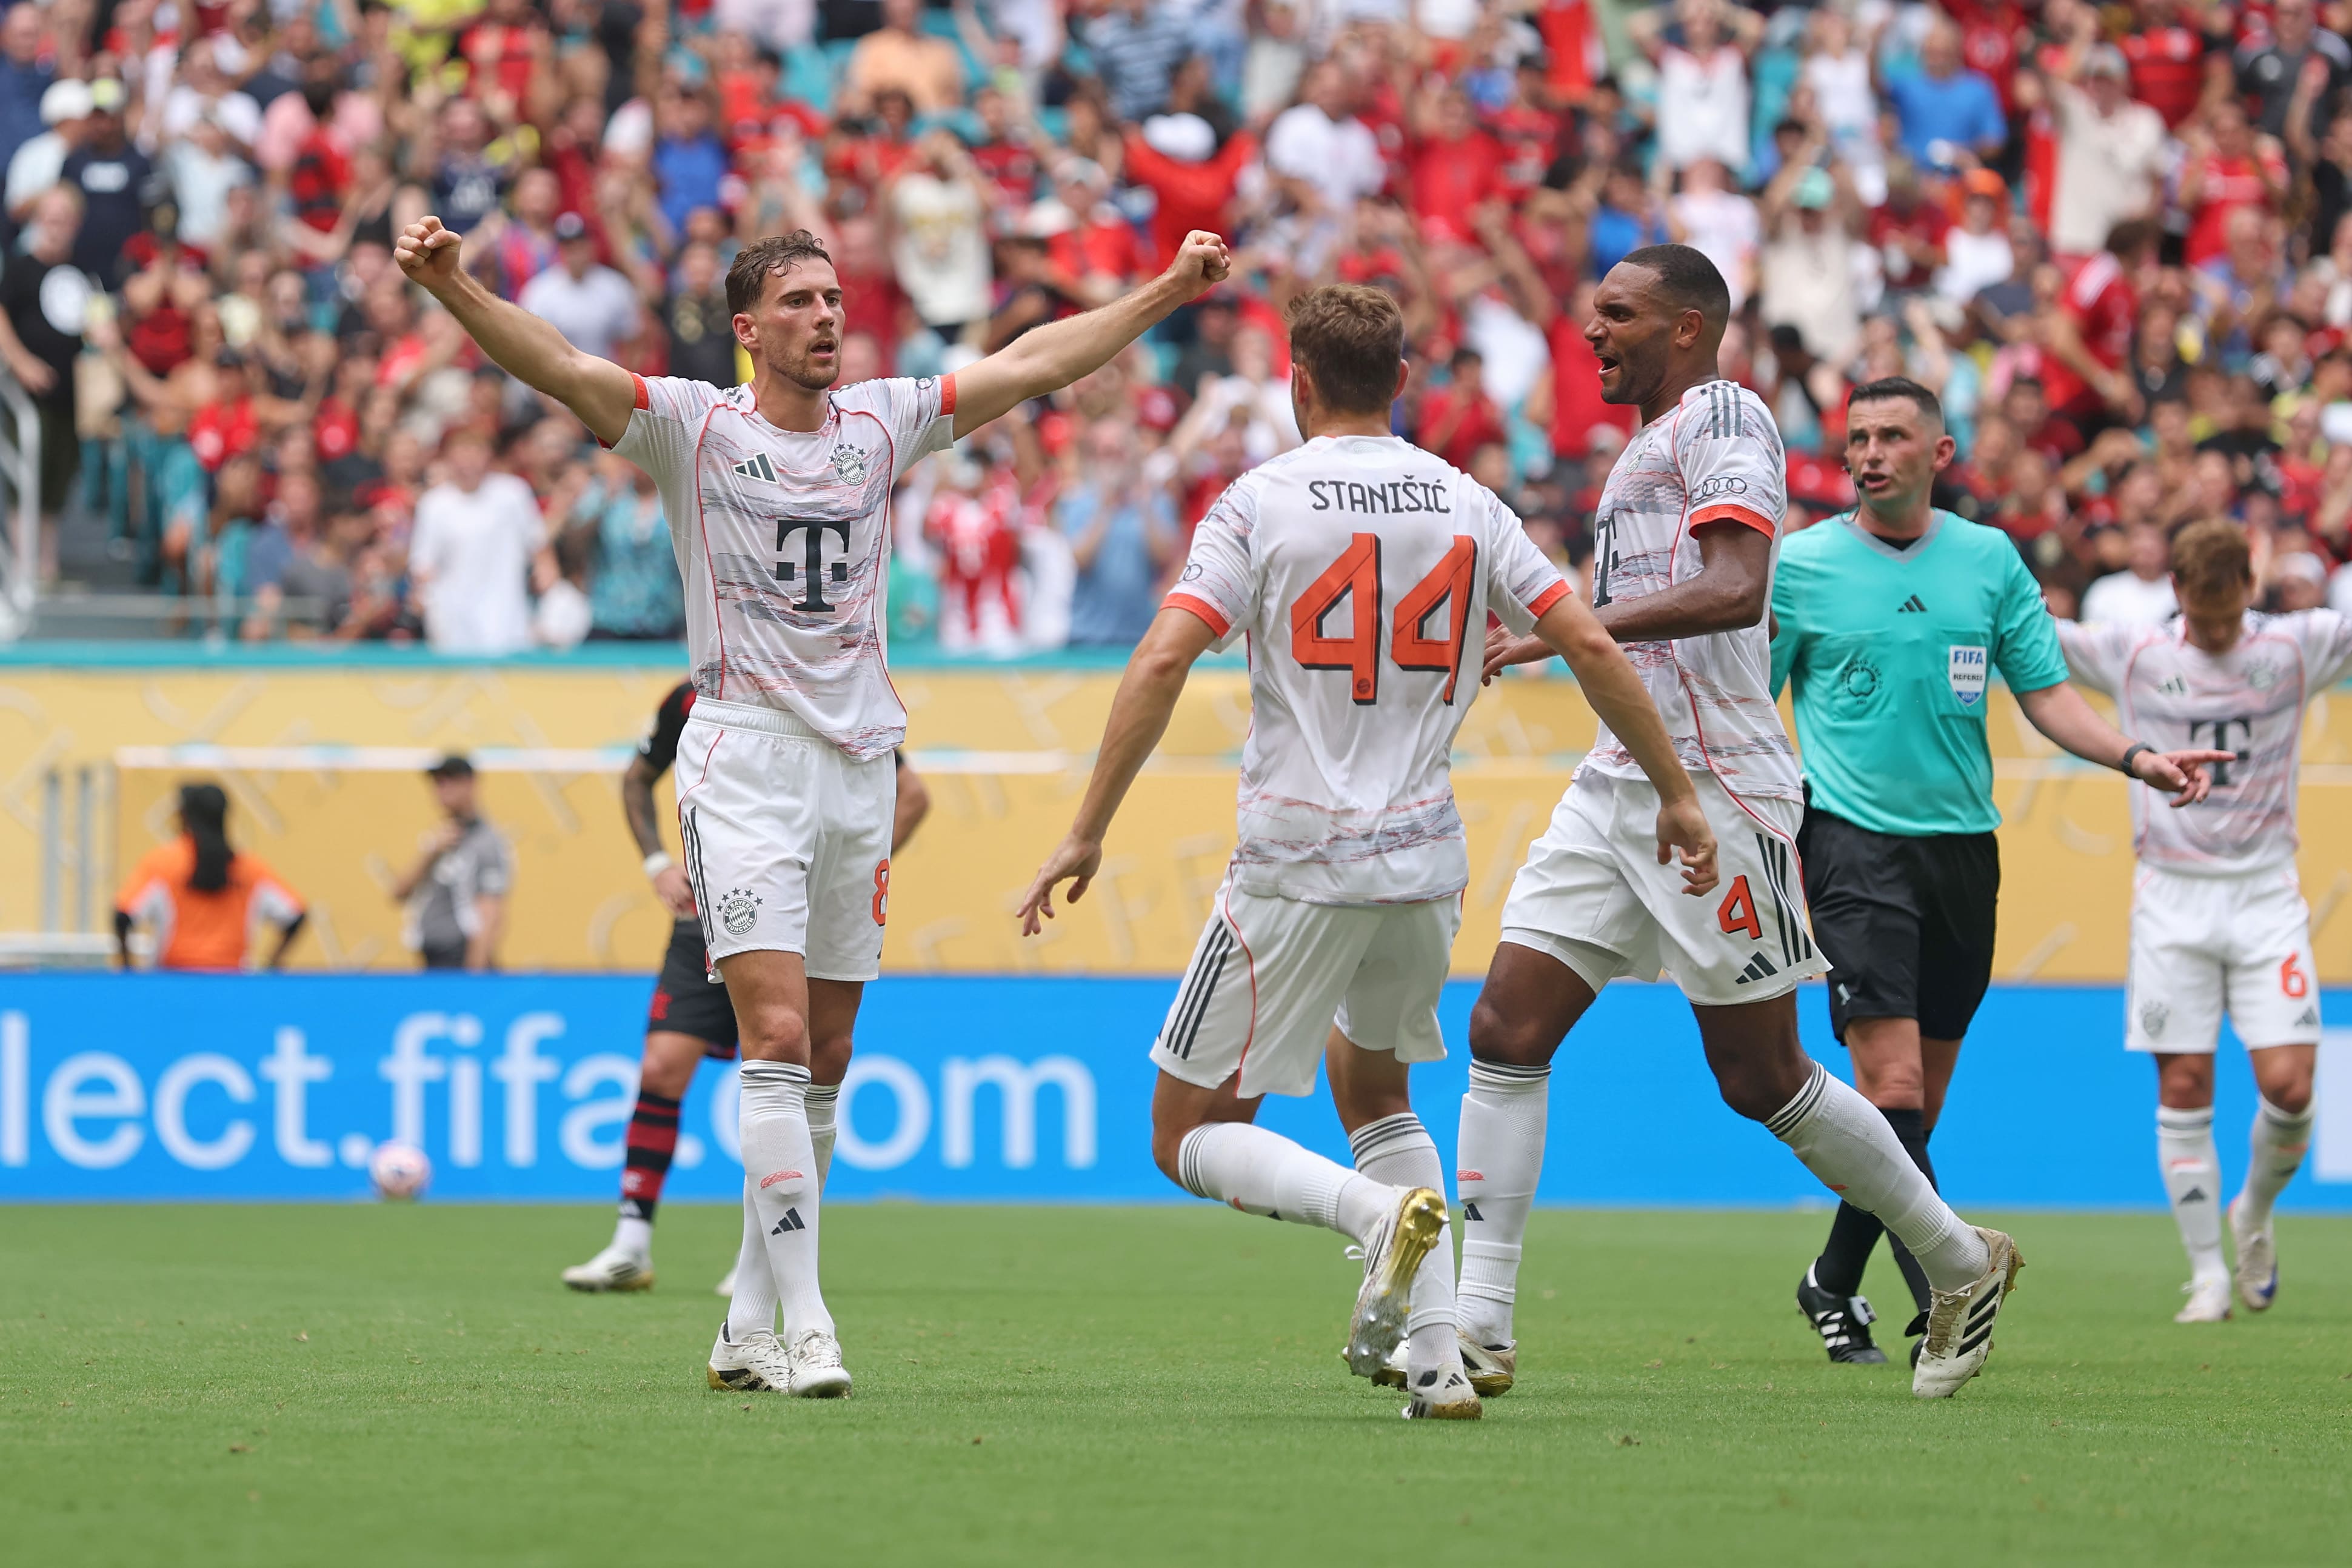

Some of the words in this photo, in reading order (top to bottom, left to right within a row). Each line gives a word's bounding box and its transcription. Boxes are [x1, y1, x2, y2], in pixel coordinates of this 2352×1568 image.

[840, 454, 861, 464] BAYERN
[1309, 475, 1452, 515] STANIŠIĆ
[776, 520, 850, 612] T
[1291, 532, 1478, 706] 44
[1954, 650, 1983, 664] FIFA
[730, 901, 753, 912] BAYERN
[872, 858, 890, 927] 8
[1717, 874, 1763, 940] 4
[2280, 951, 2308, 998] 6
